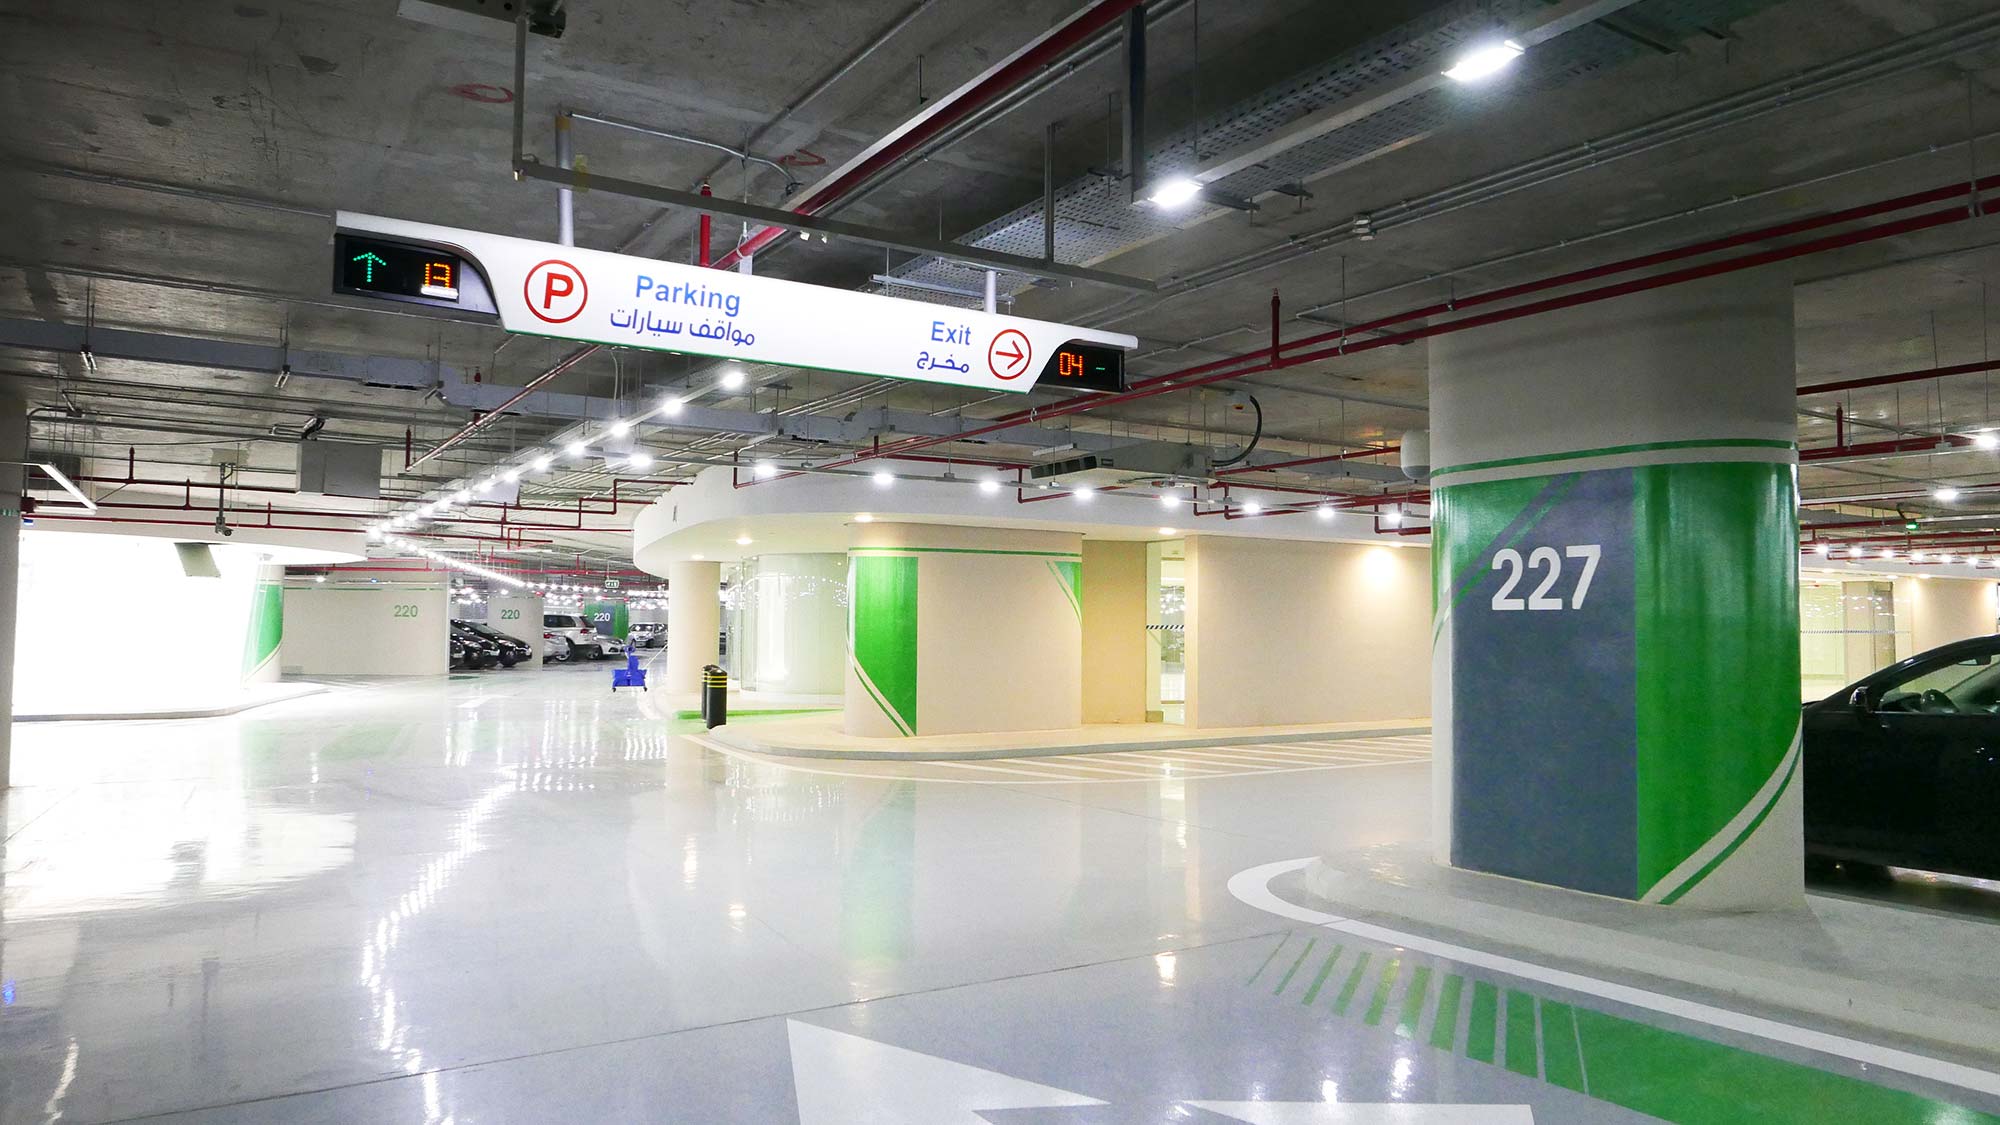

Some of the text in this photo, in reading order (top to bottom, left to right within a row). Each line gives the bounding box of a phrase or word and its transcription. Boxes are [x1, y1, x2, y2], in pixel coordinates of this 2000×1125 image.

[424, 262, 451, 290] 13
[543, 272, 576, 310] P
[635, 274, 741, 318] Parking
[610, 308, 756, 347] مواقف سيارات
[930, 320, 972, 346] Exit
[916, 350, 970, 374] مخرج
[1059, 352, 1084, 376] 04
[1491, 544, 1602, 611] 227
[394, 604, 418, 618] 220
[501, 609, 520, 620] 220
[593, 612, 611, 622] 220
